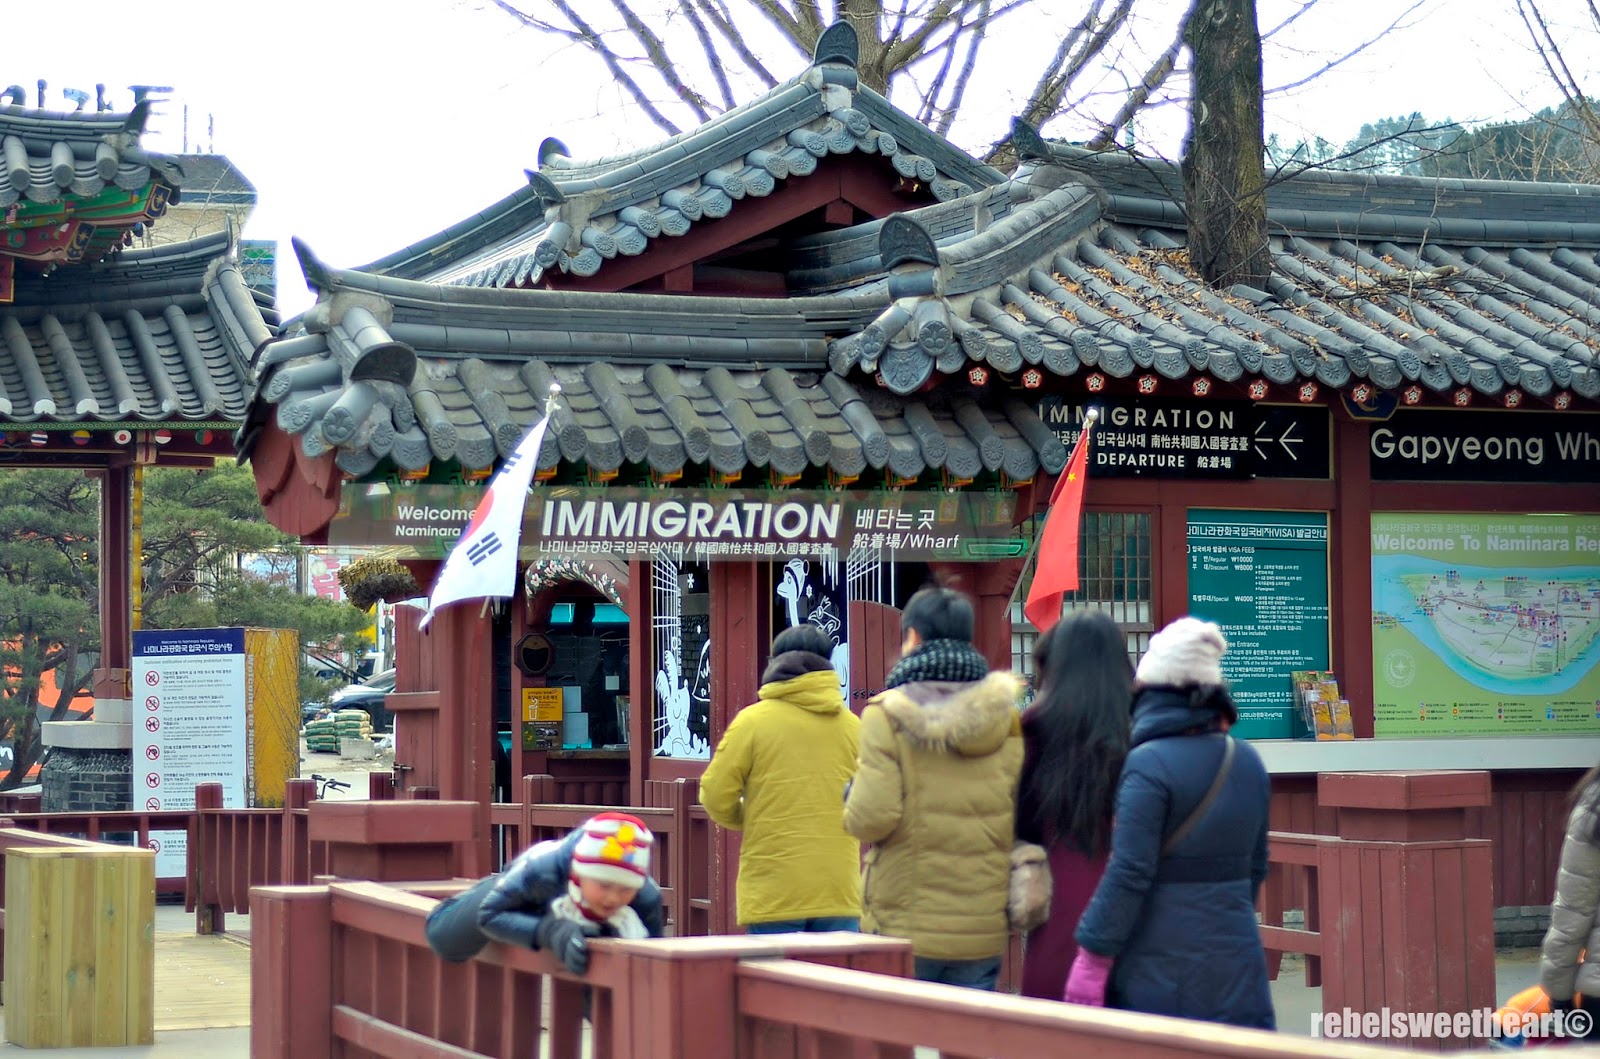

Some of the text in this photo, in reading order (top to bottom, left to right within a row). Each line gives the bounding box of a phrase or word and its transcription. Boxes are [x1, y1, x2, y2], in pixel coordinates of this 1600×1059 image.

[1096, 432, 1146, 448] 입국심사대
[1371, 428, 1544, 465] Gapyeong
[1097, 452, 1185, 468] DEPARTURE
[1197, 455, 1232, 470] 船着場
[398, 505, 477, 521] Welcome
[542, 500, 841, 539] IMMIGRATION
[856, 508, 913, 530] 배타는
[395, 524, 461, 537] Naminara
[1372, 534, 1600, 554] Welcome To Naminara Re
[143, 644, 188, 654] 나미나라공화국
[208, 642, 233, 652] 주의사항
